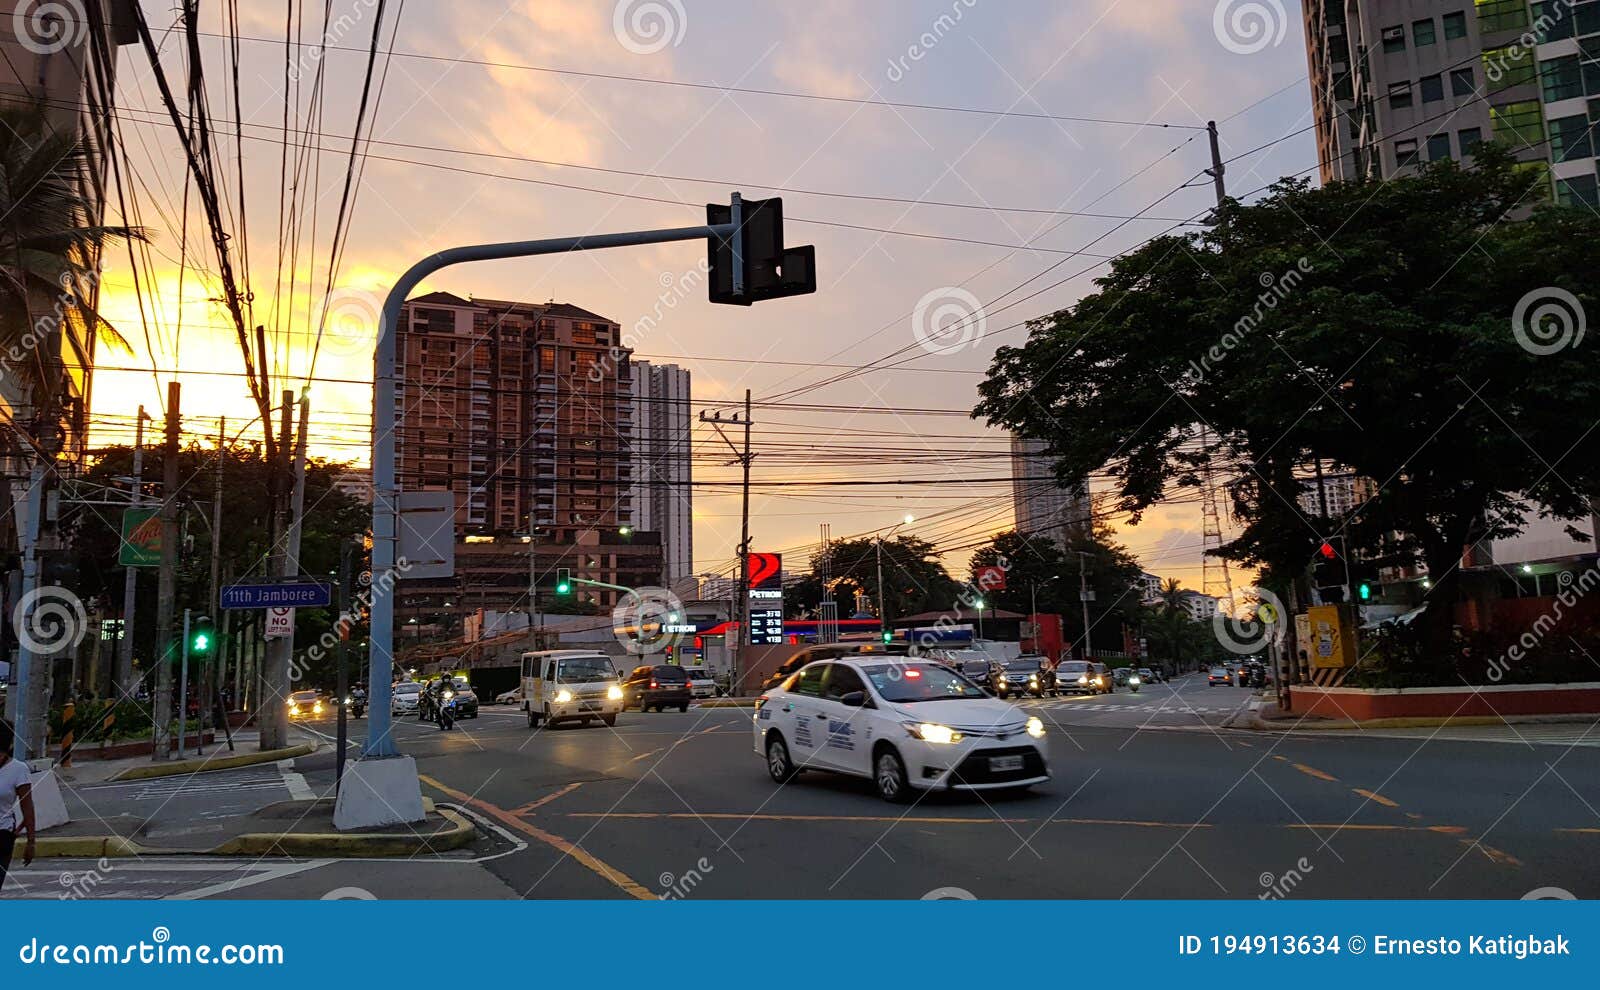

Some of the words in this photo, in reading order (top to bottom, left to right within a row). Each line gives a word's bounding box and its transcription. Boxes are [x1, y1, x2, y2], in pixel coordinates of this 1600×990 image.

[229, 590, 252, 602] 11th
[256, 588, 316, 602] Jamboree
[272, 617, 288, 626] NO
